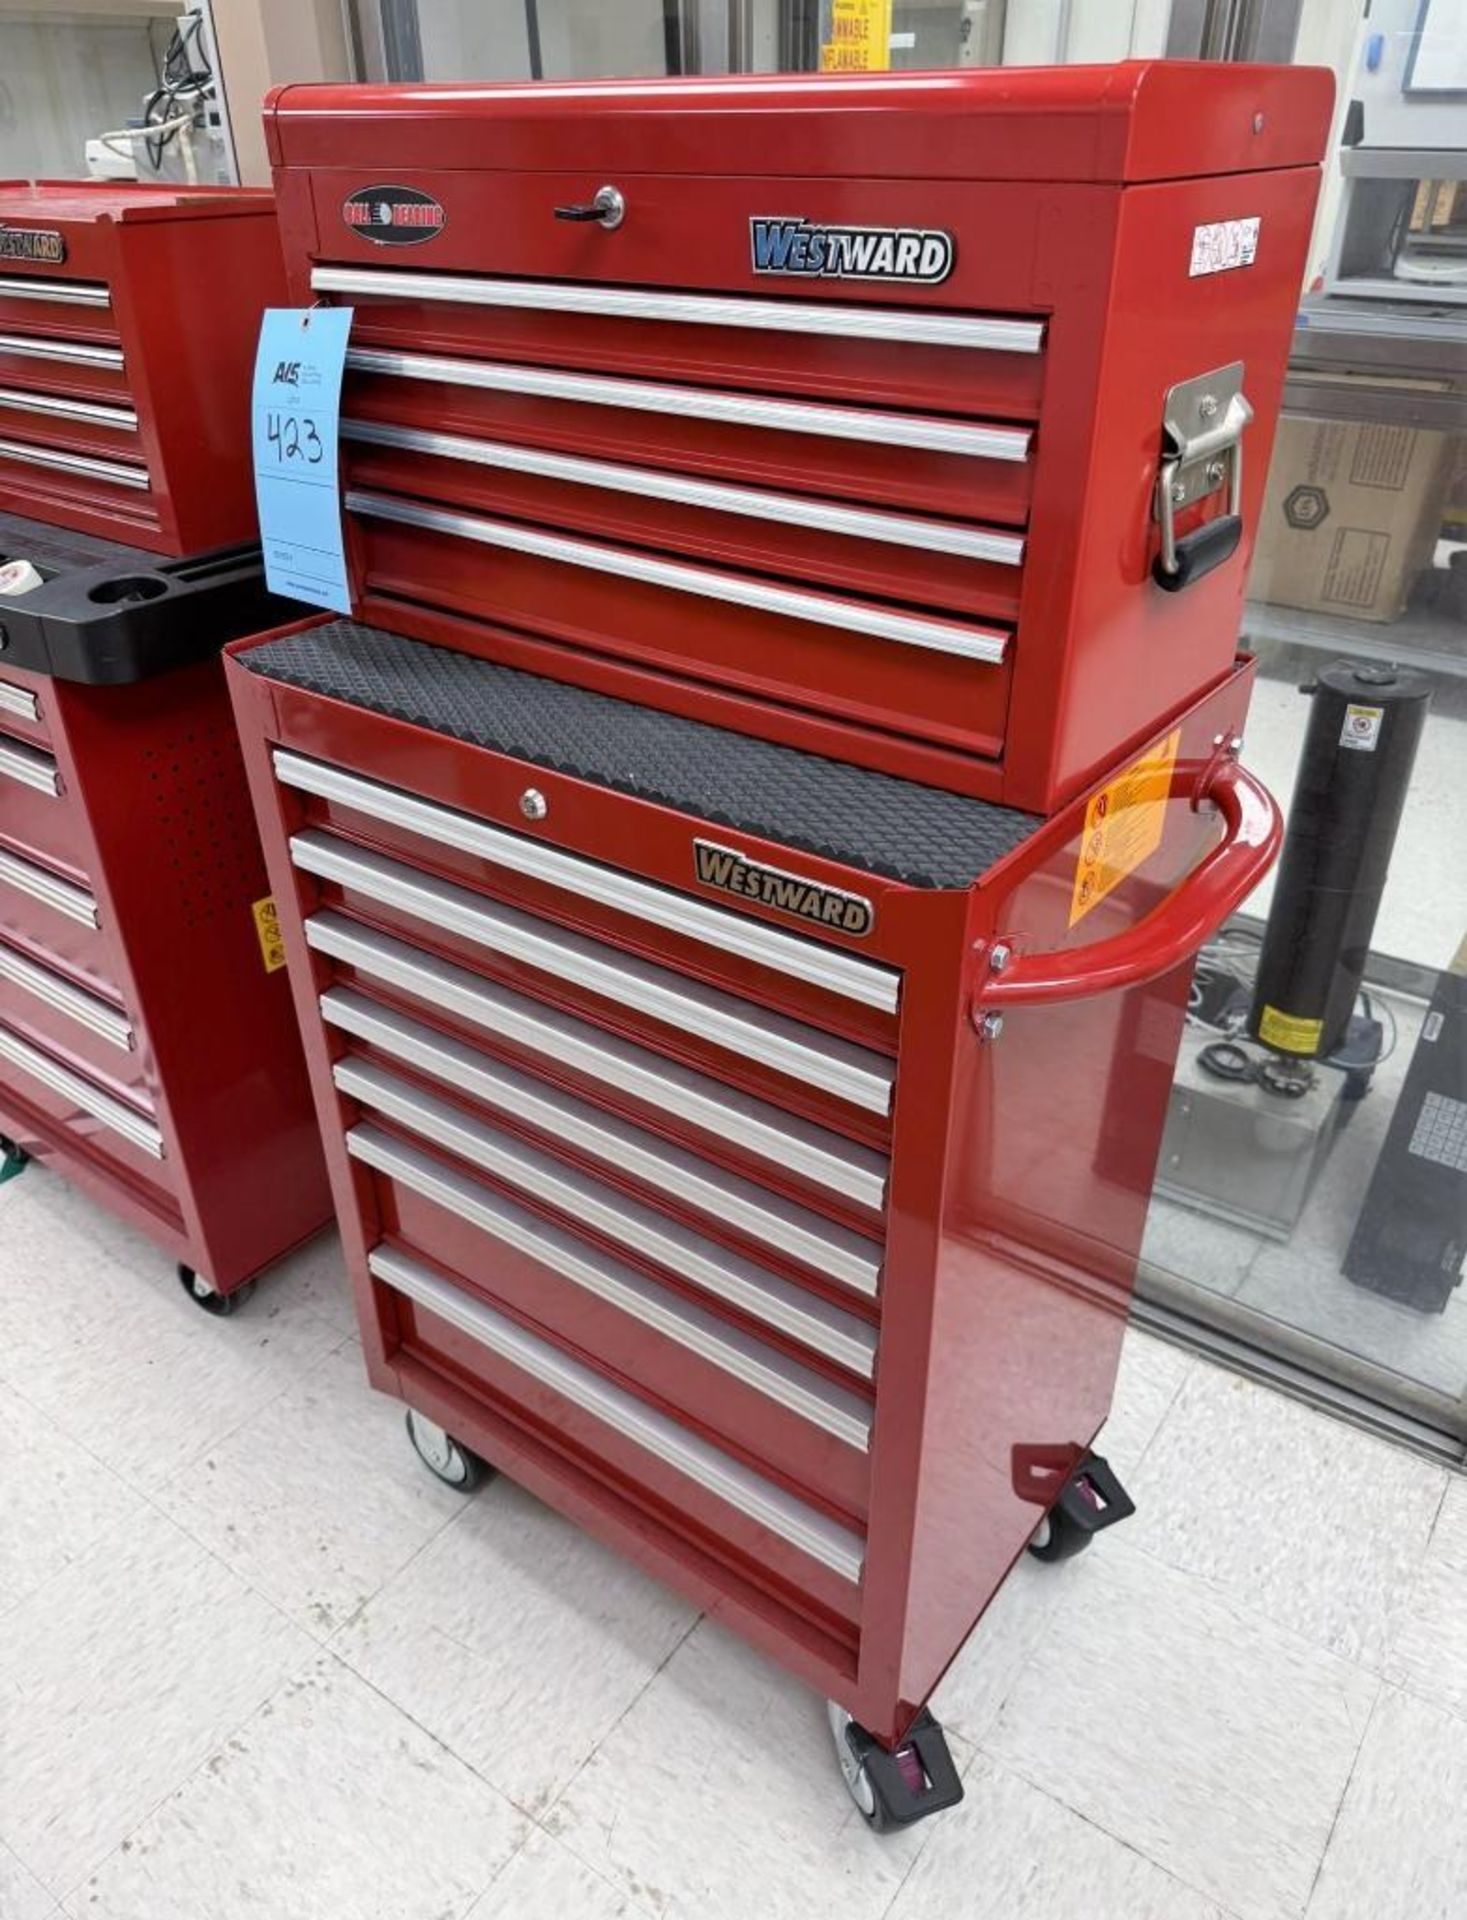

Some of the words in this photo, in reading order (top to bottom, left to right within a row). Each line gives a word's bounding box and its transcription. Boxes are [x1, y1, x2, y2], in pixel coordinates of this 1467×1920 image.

[343, 201, 371, 226] BALL
[755, 222, 947, 276] WESTWARD
[267, 413, 323, 463] 423
[698, 847, 867, 931] WESTWARD
